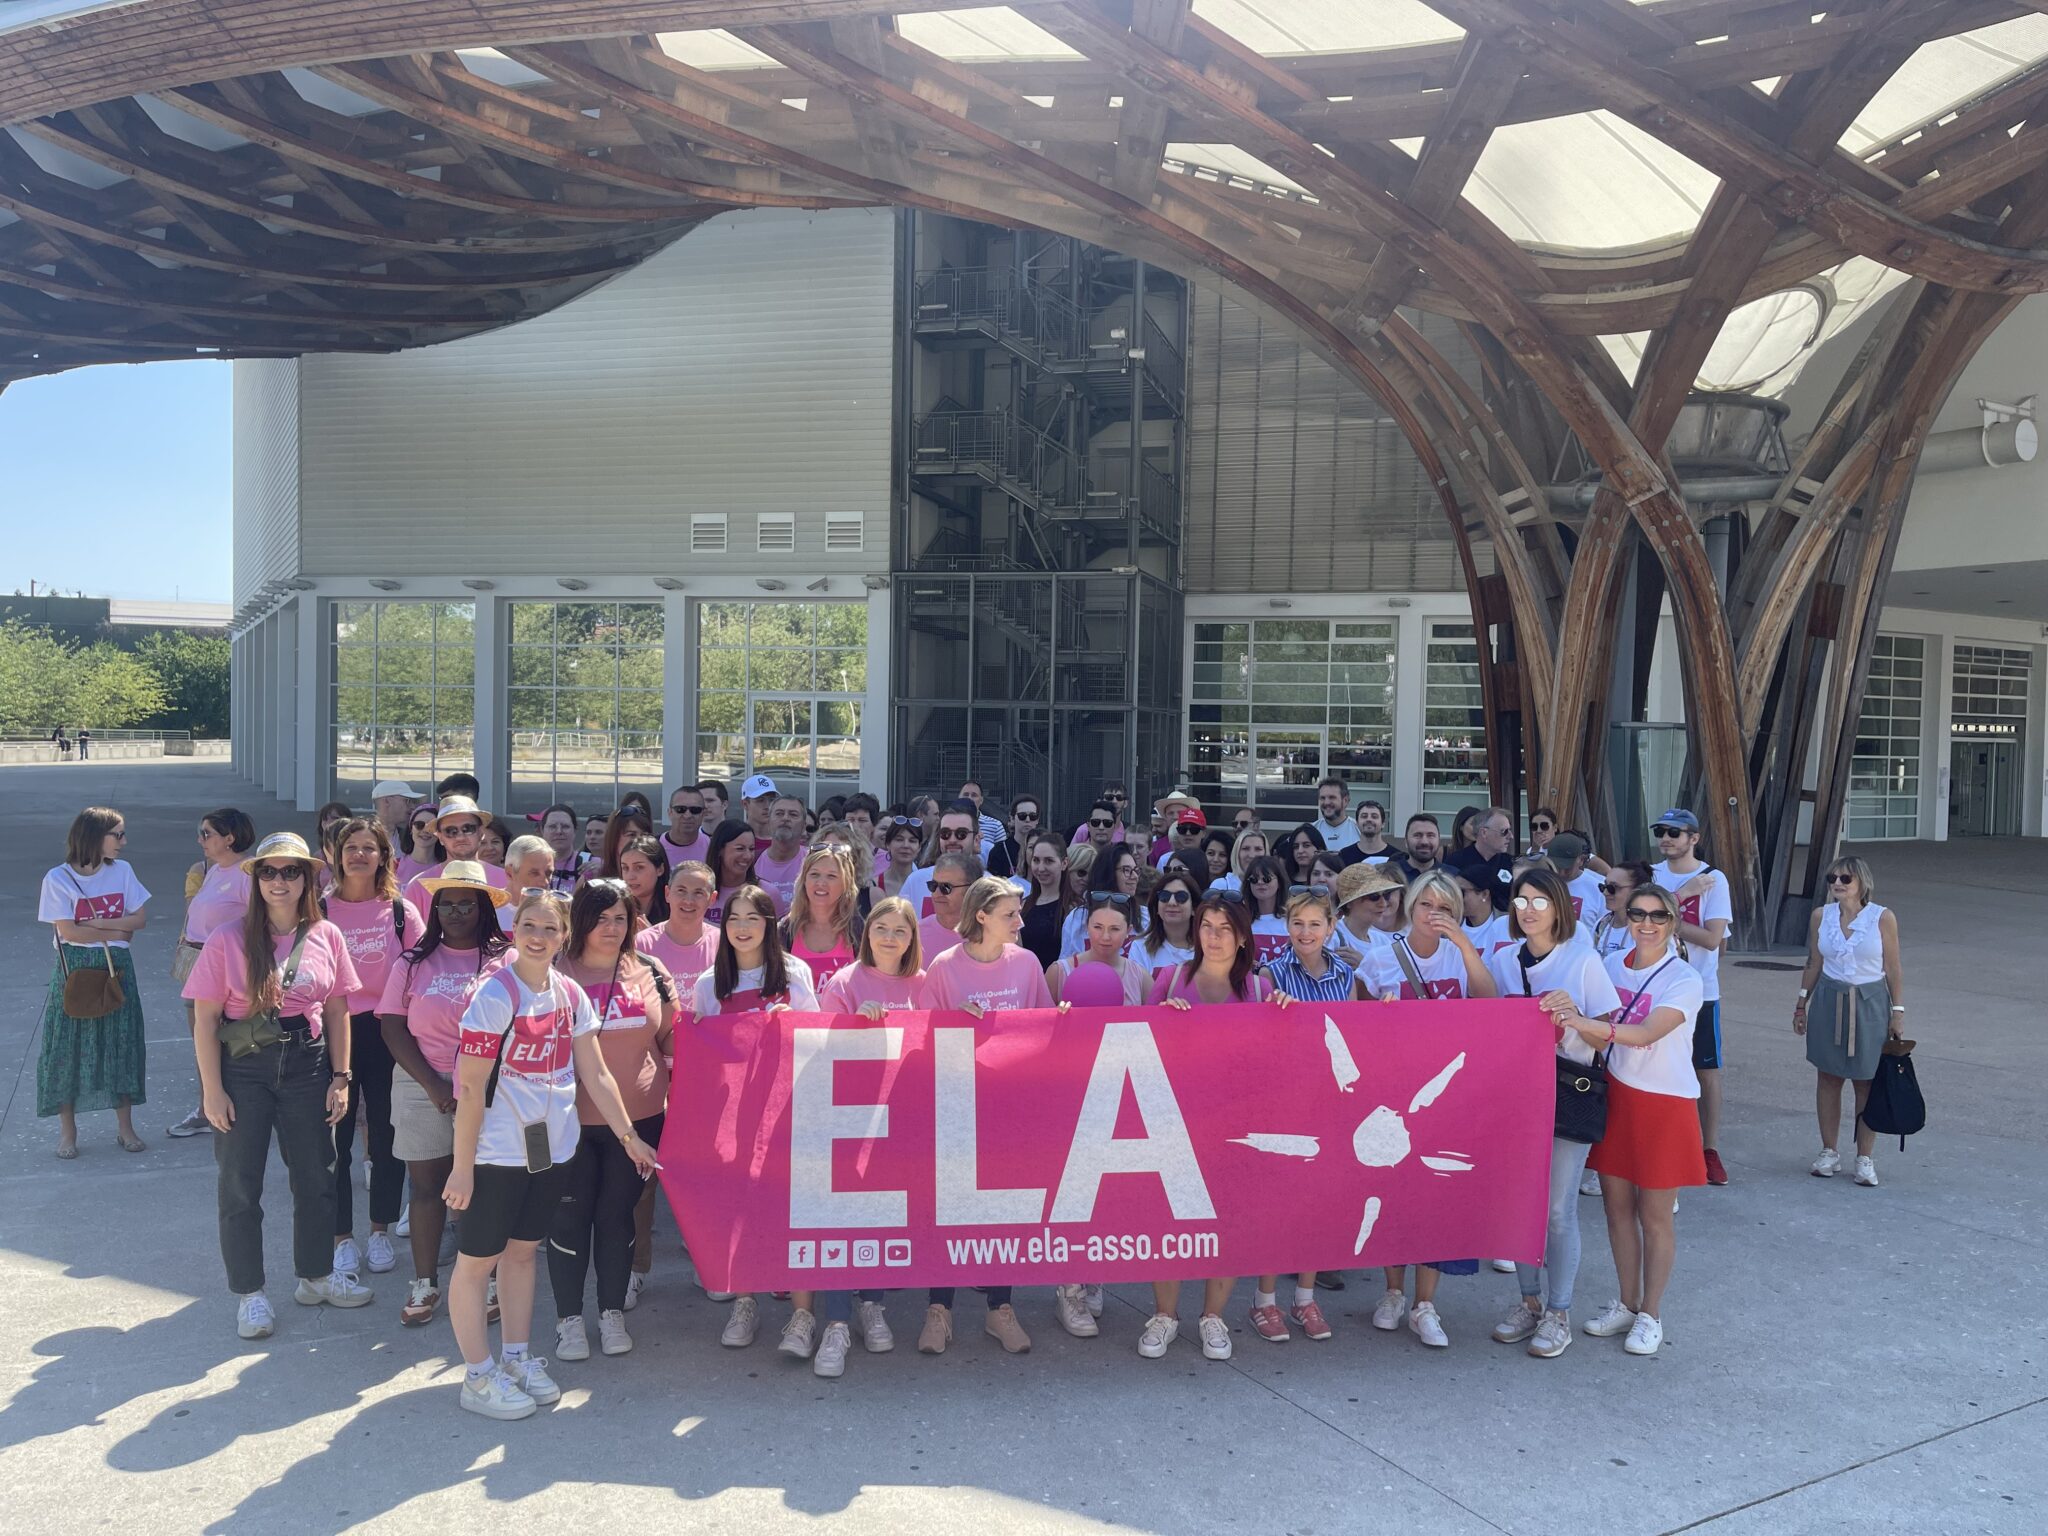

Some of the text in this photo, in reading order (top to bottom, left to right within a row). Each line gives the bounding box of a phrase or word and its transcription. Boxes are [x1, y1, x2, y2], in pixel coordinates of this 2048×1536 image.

[593, 997, 623, 1022] LA
[464, 1044, 482, 1055] ELA
[512, 1041, 555, 1061] ELA
[788, 1022, 1218, 1229] ELA
[946, 1228, 1219, 1266] www.ela-asso.com
